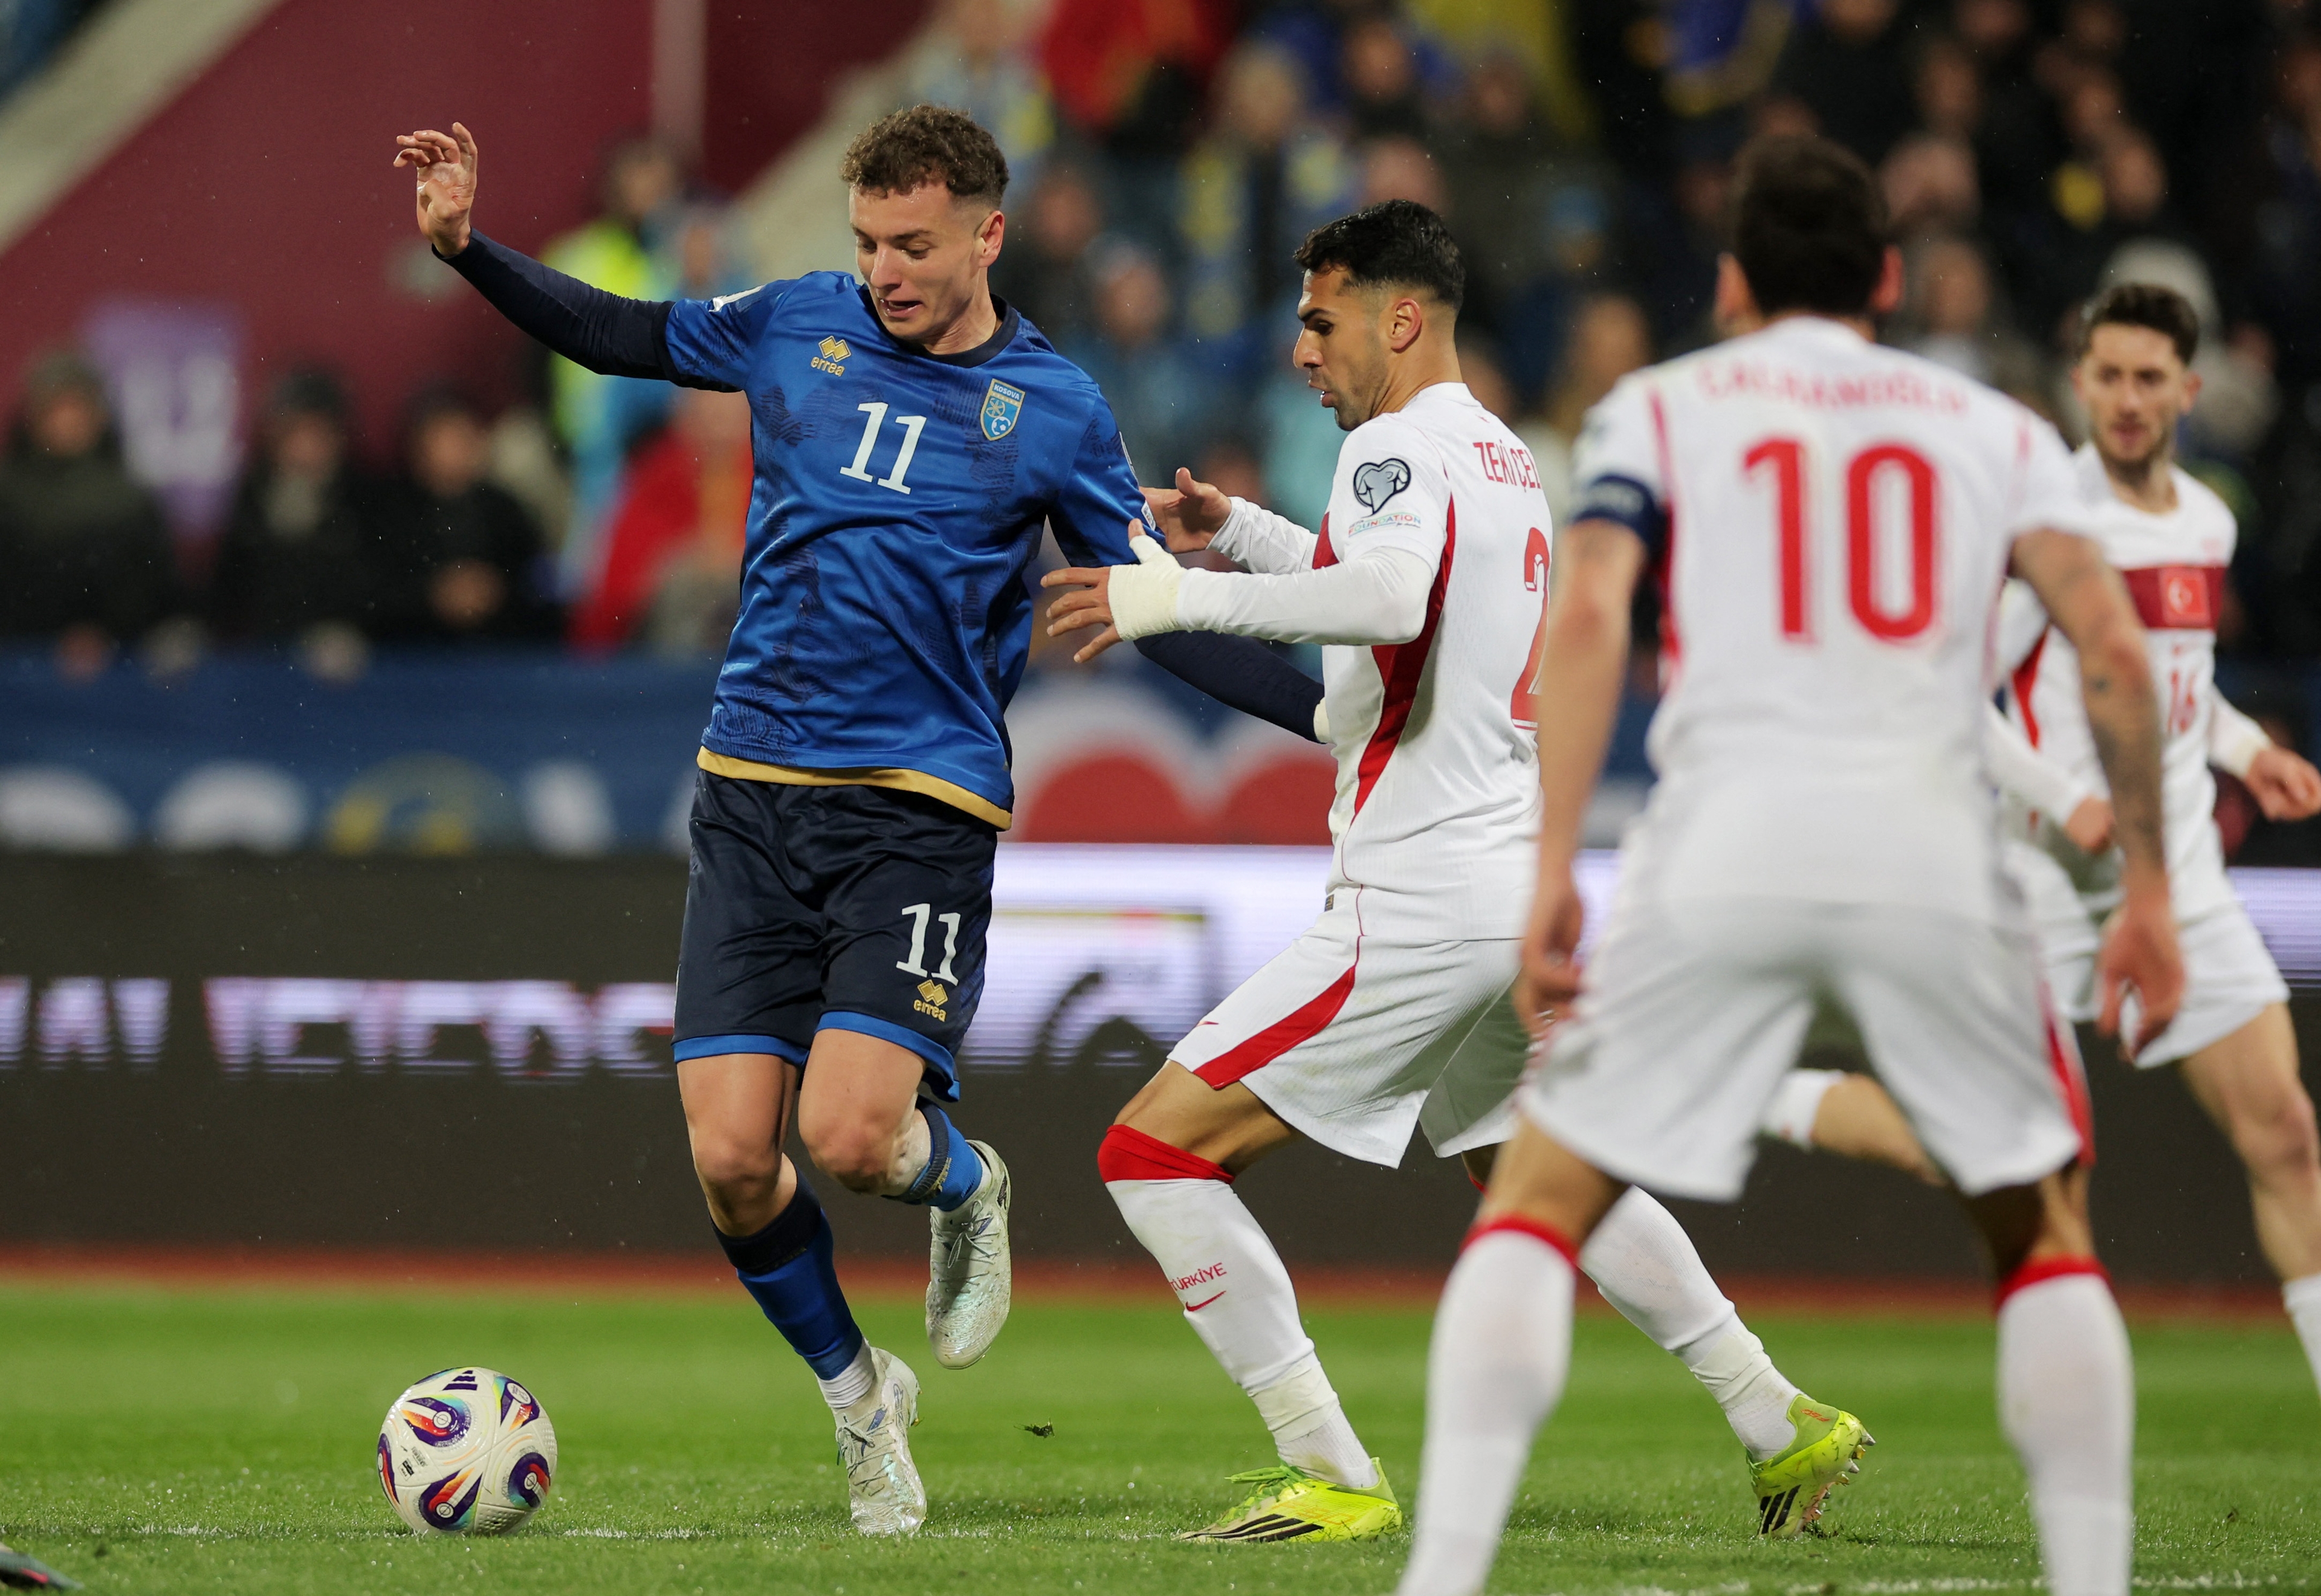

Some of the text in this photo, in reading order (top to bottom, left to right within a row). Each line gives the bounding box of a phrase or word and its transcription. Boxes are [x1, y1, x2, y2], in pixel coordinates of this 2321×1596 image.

[811, 357, 845, 377] errea
[993, 384, 1020, 400] KOSOVA
[840, 402, 927, 495] 11
[1744, 439, 1941, 643] 10
[1510, 526, 1550, 731] 2
[2168, 668, 2198, 735] 16
[896, 903, 961, 986] 11
[913, 999, 947, 1022] errea
